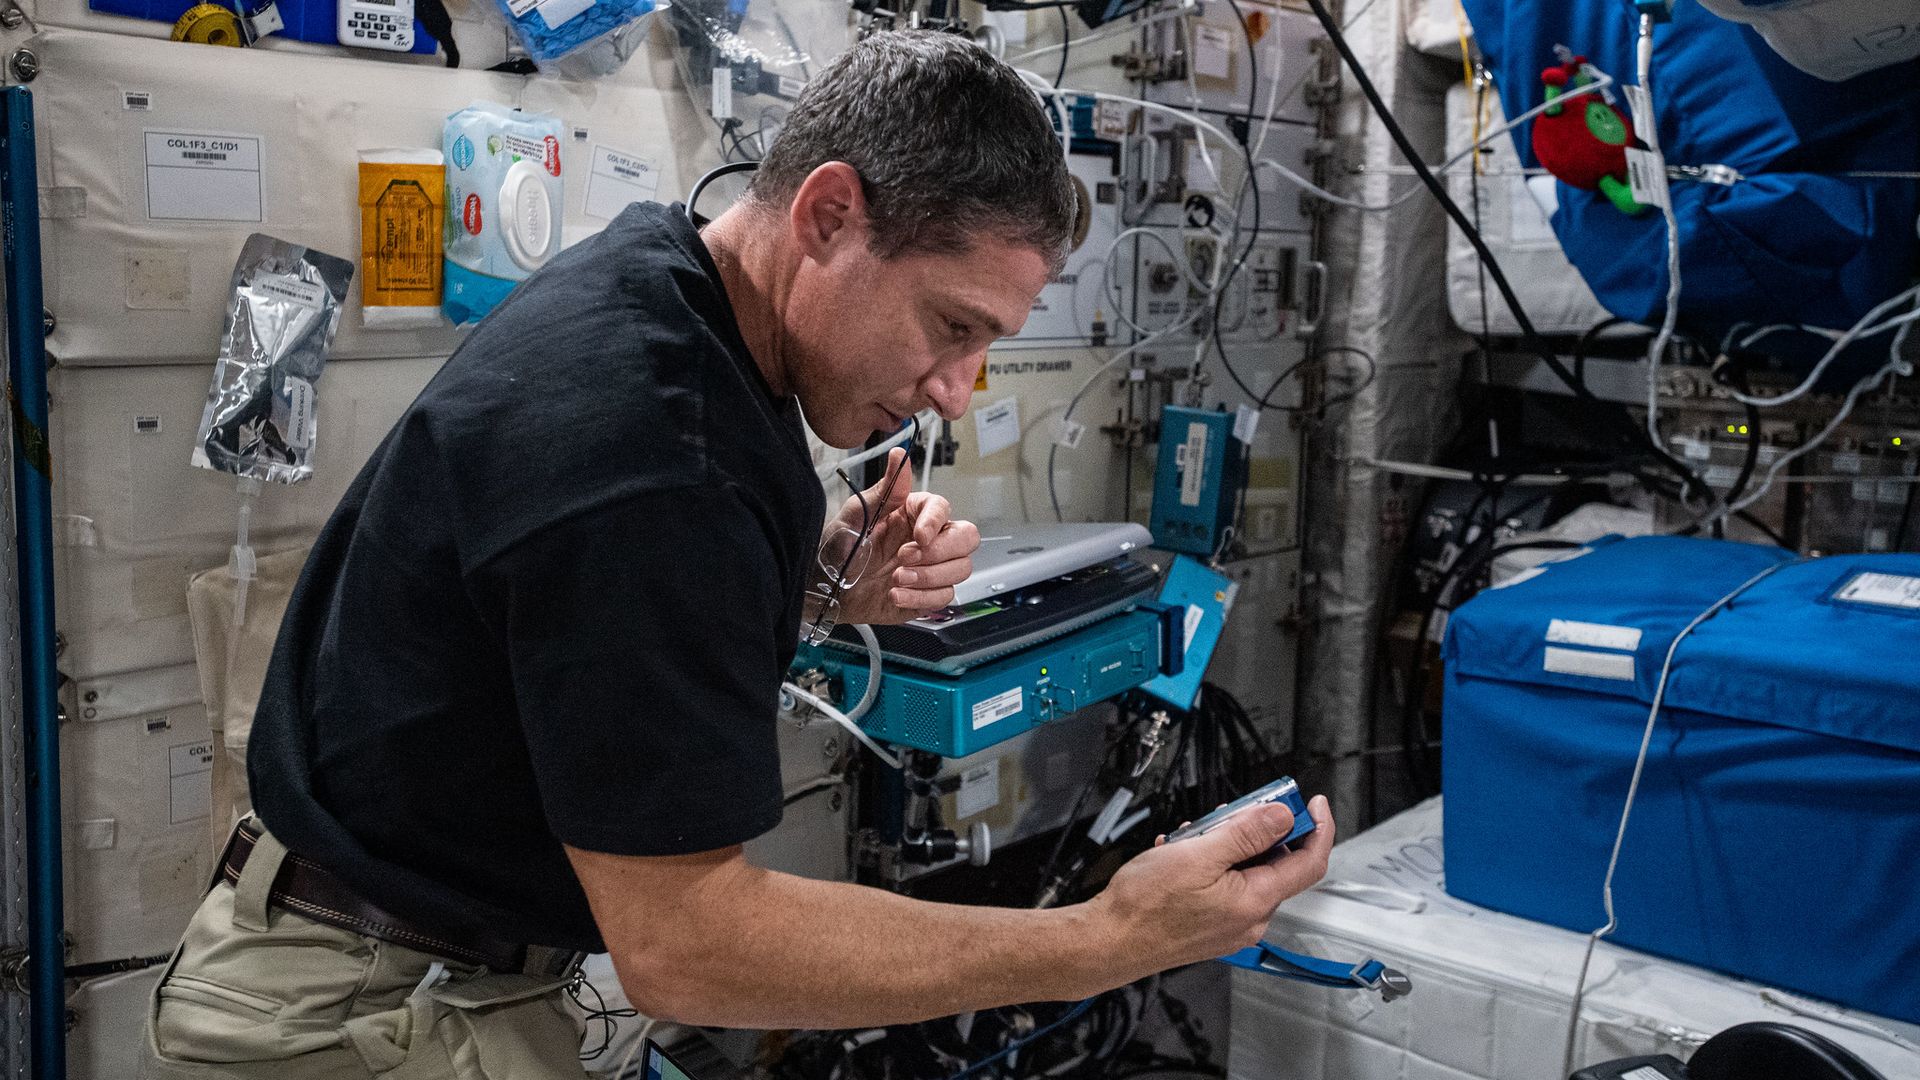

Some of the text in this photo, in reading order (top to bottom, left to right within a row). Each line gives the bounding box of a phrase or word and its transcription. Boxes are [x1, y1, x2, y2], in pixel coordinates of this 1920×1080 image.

[166, 138, 240, 152] COL1F3_C1/D1
[988, 360, 1073, 374] PU UTILITY DRAWER
[294, 385, 306, 442] Drinking Water
